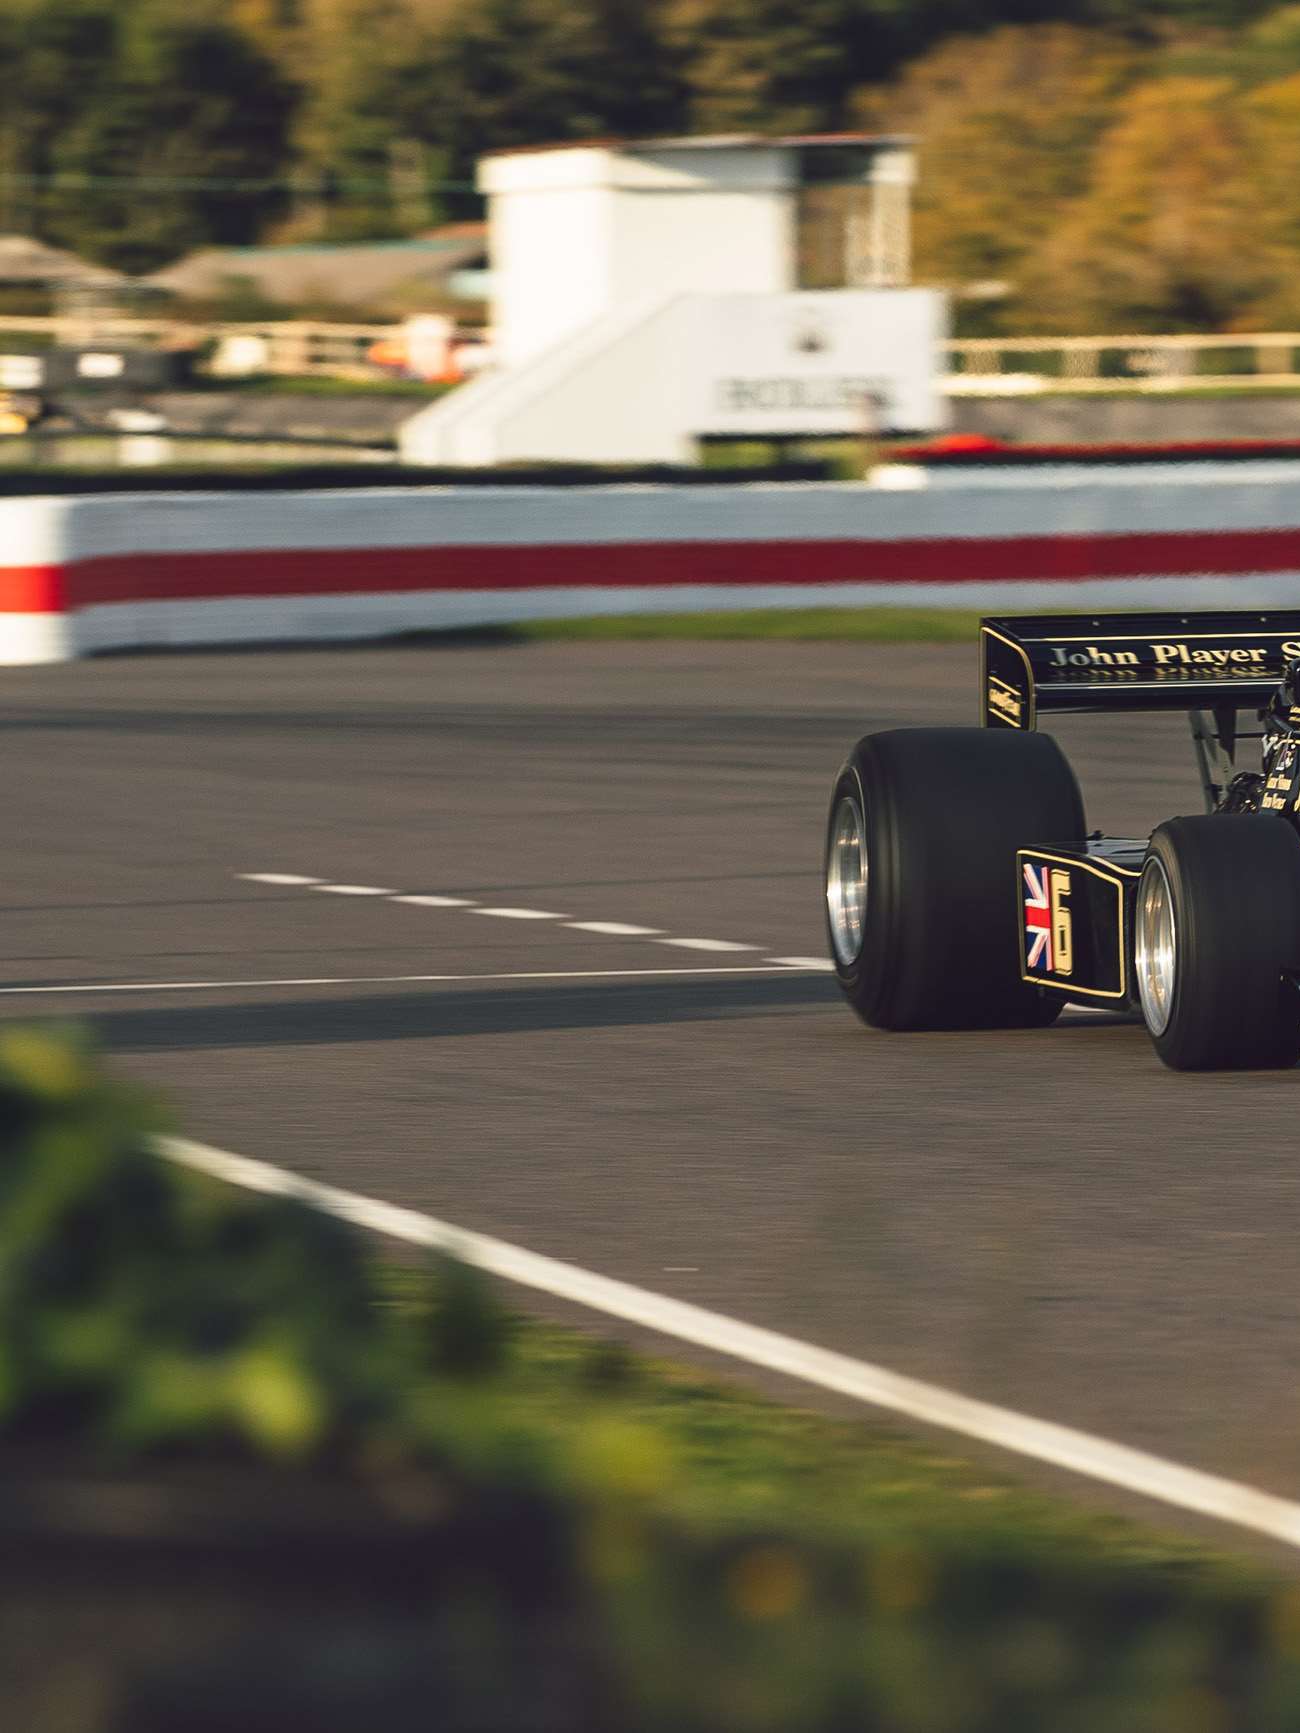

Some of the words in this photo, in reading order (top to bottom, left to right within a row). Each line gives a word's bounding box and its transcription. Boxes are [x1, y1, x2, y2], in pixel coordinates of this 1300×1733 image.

[1050, 646, 1141, 666] John
[1150, 643, 1267, 666] Player
[1050, 868, 1073, 976] 6
